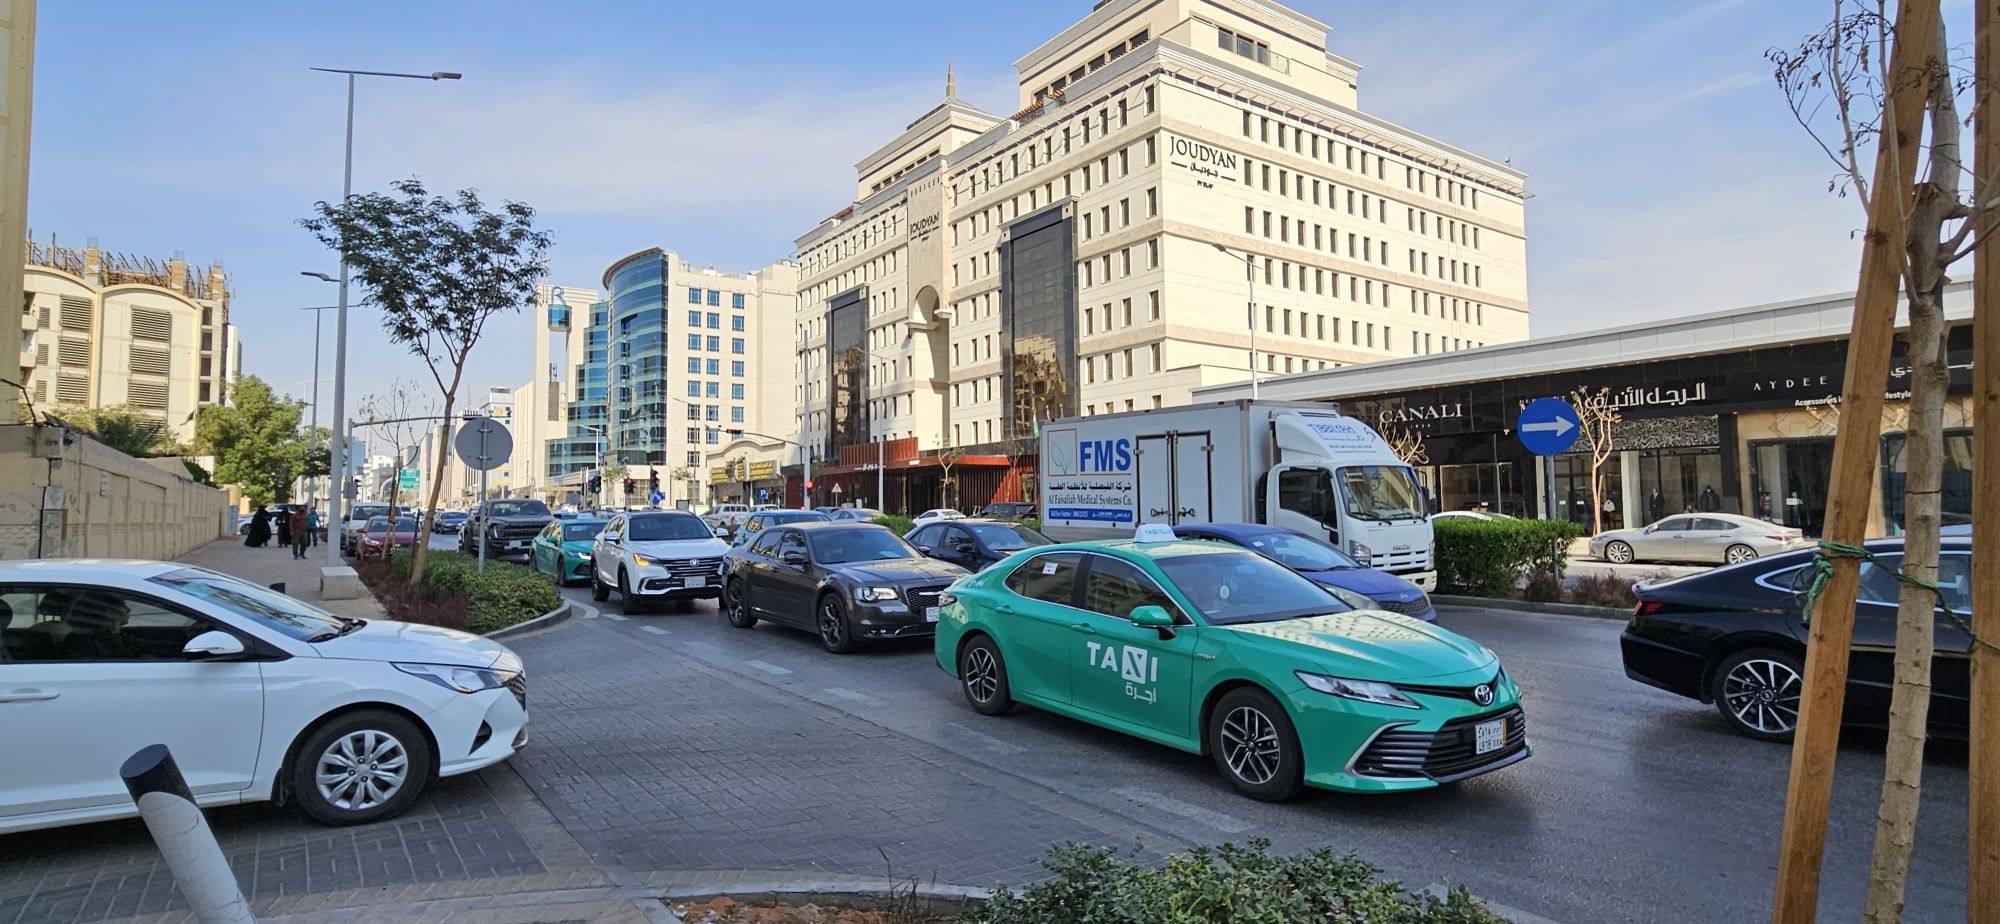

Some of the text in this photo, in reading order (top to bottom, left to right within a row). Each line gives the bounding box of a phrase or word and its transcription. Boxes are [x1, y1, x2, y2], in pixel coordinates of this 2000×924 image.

[1170, 136, 1236, 170] JOUDYAN
[910, 211, 940, 236] JOUDYAN
[1754, 375, 1829, 391] AYDEE
[1379, 403, 1463, 423] CANALI
[1079, 438, 1131, 472] FMS
[1115, 481, 1132, 492] شركة
[1048, 494, 1133, 508] Al Faisaliah Medical Systems Co.
[1087, 641, 1158, 685] TAXI
